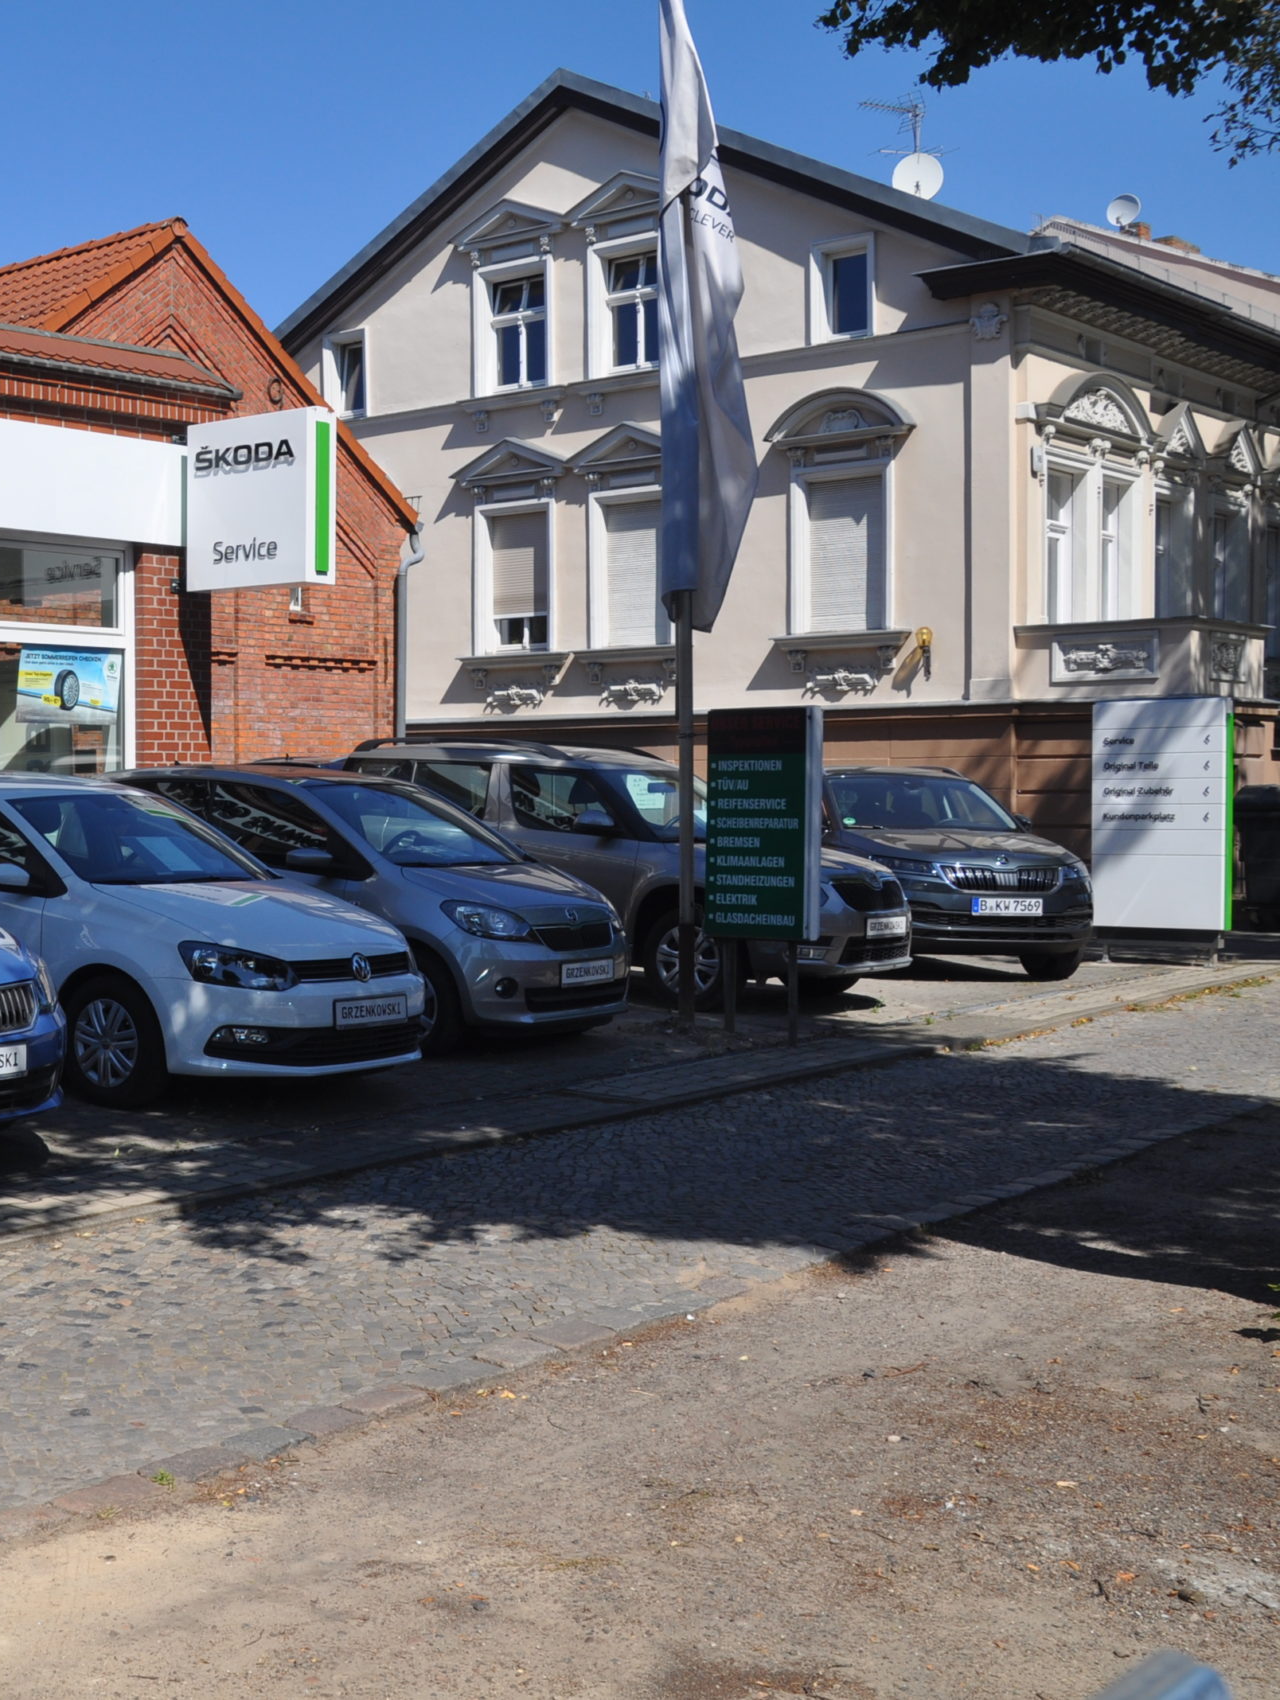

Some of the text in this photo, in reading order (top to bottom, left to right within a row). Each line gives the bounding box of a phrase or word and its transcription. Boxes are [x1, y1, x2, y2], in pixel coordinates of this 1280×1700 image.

[195, 439, 295, 472] ŠKODA
[213, 537, 277, 565] Service
[1103, 737, 1135, 746] Service
[718, 760, 782, 771] INSPEKTIONEN
[1103, 761, 1159, 774] Original Teile
[1103, 786, 1174, 798] Original Zubehör
[718, 798, 787, 810] REIFENSERVICE
[716, 817, 799, 829] SCHEIBENREPARATUR
[1102, 812, 1175, 823] Kundenparkplatz
[717, 836, 760, 848] BREMSEN
[716, 855, 785, 868] KLIMAANLAGEN
[715, 874, 795, 888] STANDHEIZUNGEN
[715, 893, 758, 905] ELEKTRIK
[1013, 900, 1041, 912] 7569
[715, 912, 795, 926] GLASDACHEINBAU
[566, 964, 609, 979] GRZENKOWSKI
[341, 1002, 401, 1020] GRZENKOWSKI
